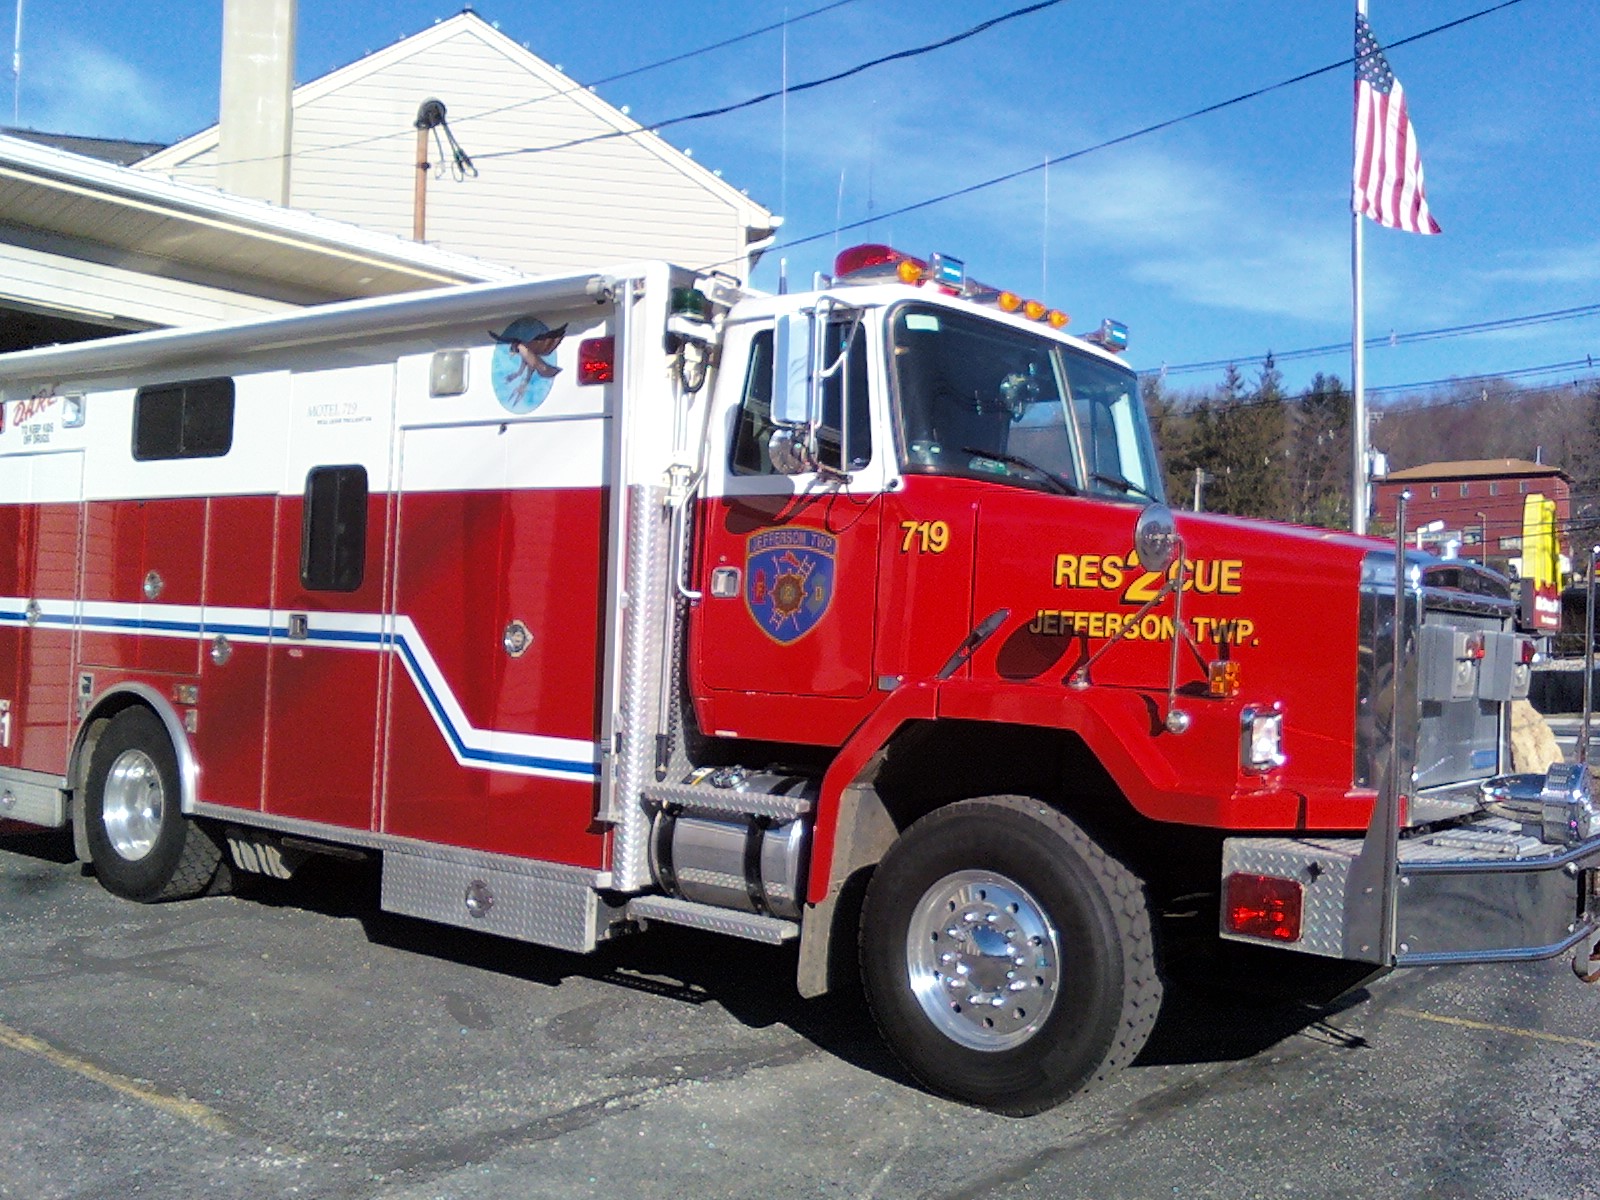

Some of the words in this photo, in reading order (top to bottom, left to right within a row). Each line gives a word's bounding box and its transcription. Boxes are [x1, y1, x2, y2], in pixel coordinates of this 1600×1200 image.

[751, 531, 807, 552] JEFFERSON
[901, 520, 949, 553] 719
[1029, 609, 1177, 641] JEFFERSON
